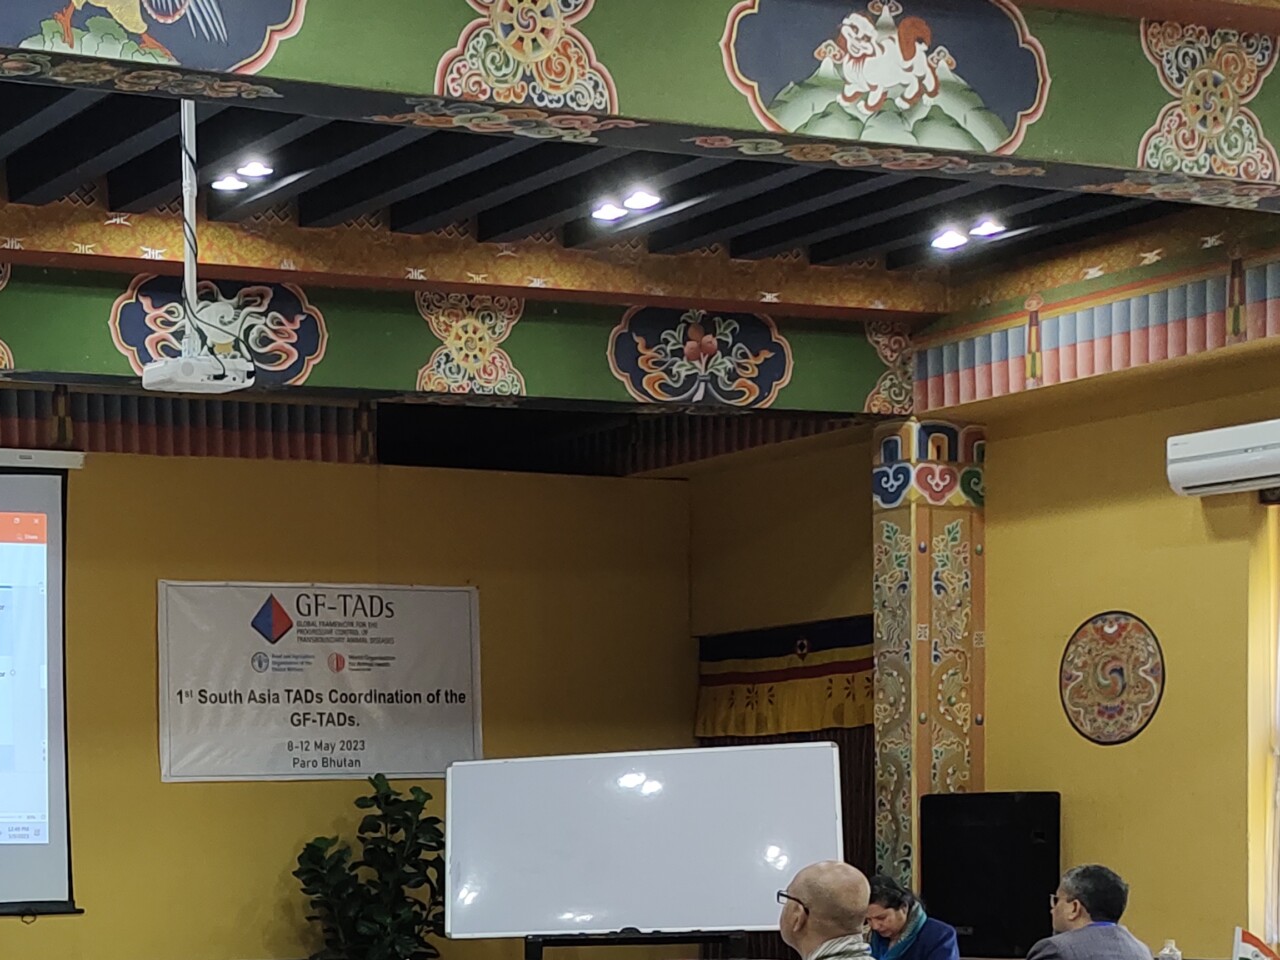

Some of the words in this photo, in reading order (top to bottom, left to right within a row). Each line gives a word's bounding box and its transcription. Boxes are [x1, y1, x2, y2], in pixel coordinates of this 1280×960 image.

[296, 593, 394, 619] GF-TADs
[176, 689, 193, 704] 1st
[198, 689, 243, 704] South
[247, 690, 280, 704] Asia
[284, 689, 324, 704] TADs
[328, 689, 422, 704] Coordination
[426, 689, 442, 704] of
[445, 690, 466, 704] the
[290, 712, 360, 727] GF-TADs.
[314, 740, 336, 754] May
[338, 740, 366, 752] 2023
[292, 757, 318, 768] Paro
[322, 757, 361, 768] Bhutan
